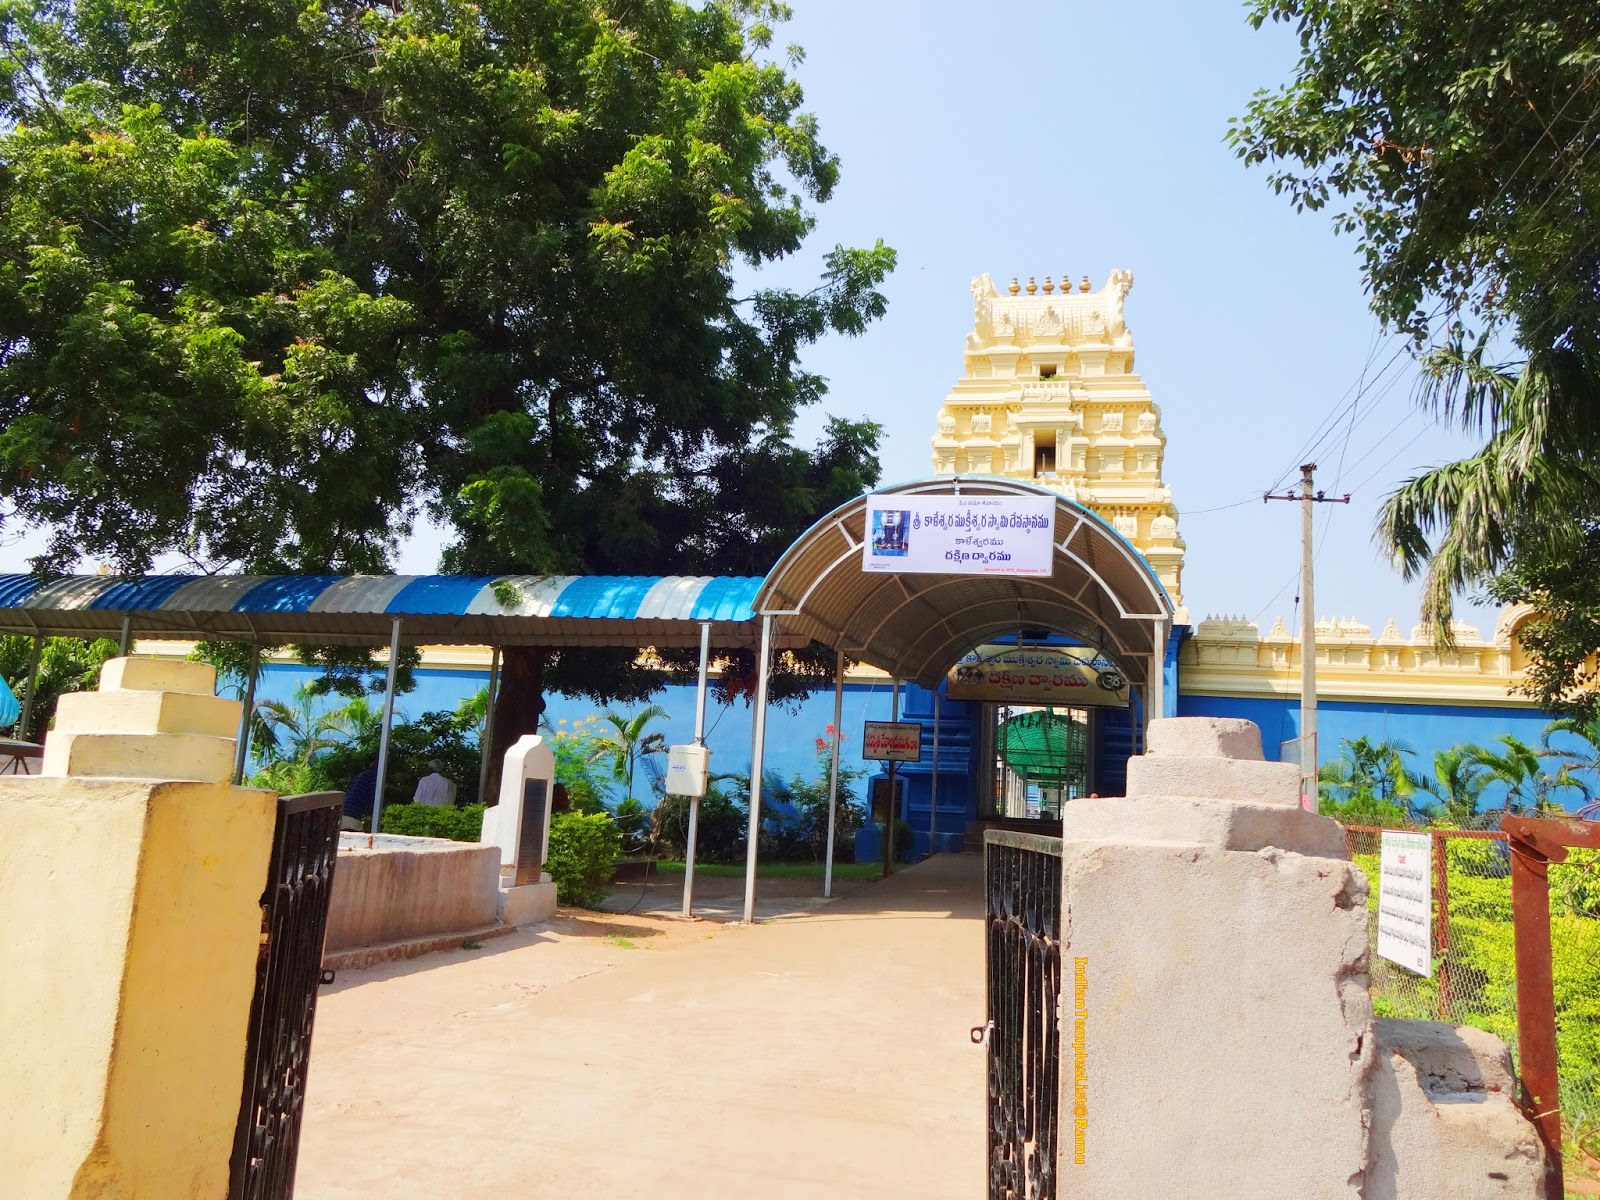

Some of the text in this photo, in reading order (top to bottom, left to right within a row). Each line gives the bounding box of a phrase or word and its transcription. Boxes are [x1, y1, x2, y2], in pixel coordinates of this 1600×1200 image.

[912, 510, 1049, 534] శ్రీ కాళేశ్వర ముక్తీశ్వర స్వామి దేవస్థానము
[955, 535, 1004, 548] కాళేశ్వరము
[945, 549, 1012, 564] దక్షిణ ద్వారము
